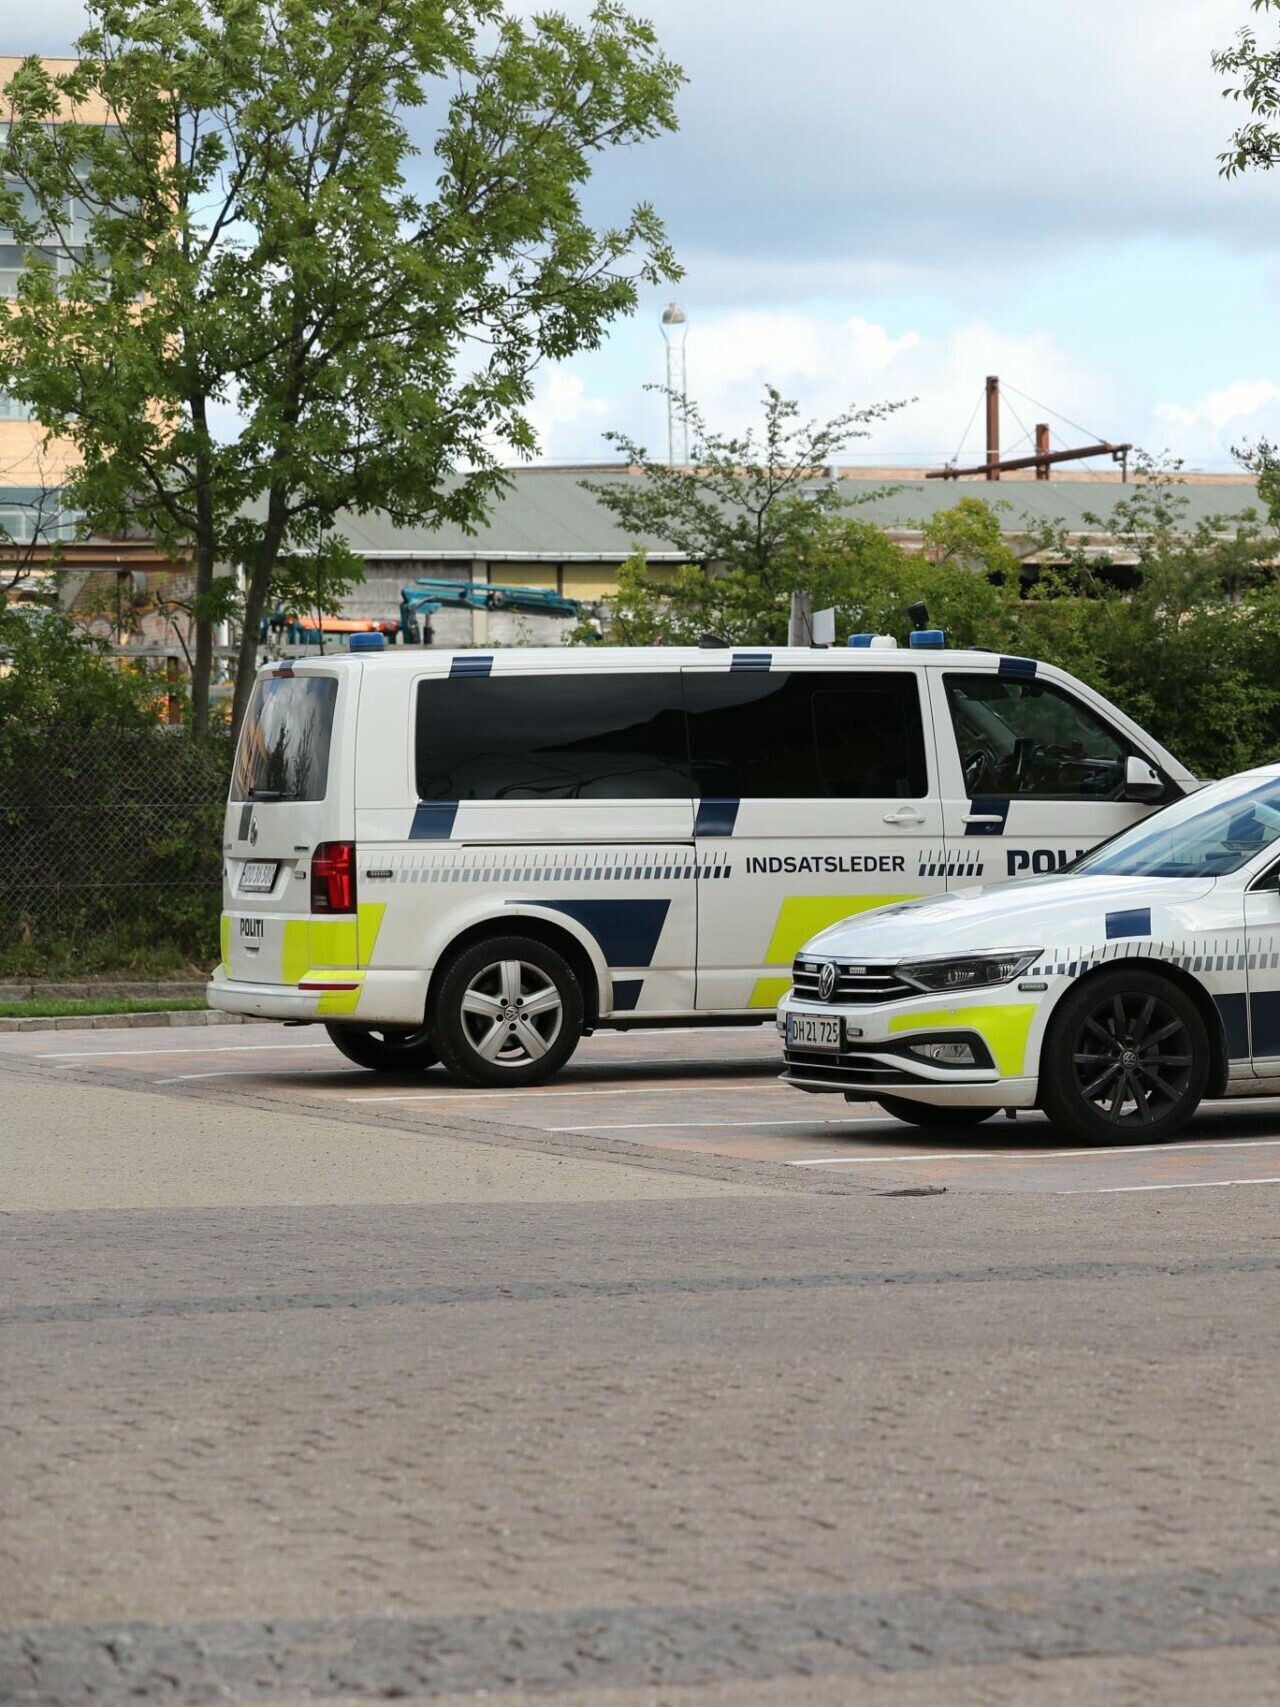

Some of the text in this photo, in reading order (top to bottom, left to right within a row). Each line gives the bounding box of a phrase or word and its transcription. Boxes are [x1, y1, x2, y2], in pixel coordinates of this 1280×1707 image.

[746, 856, 905, 874] INDSATSLEDER
[240, 918, 264, 937] POLITI
[793, 1020, 839, 1043] DH 21 725
